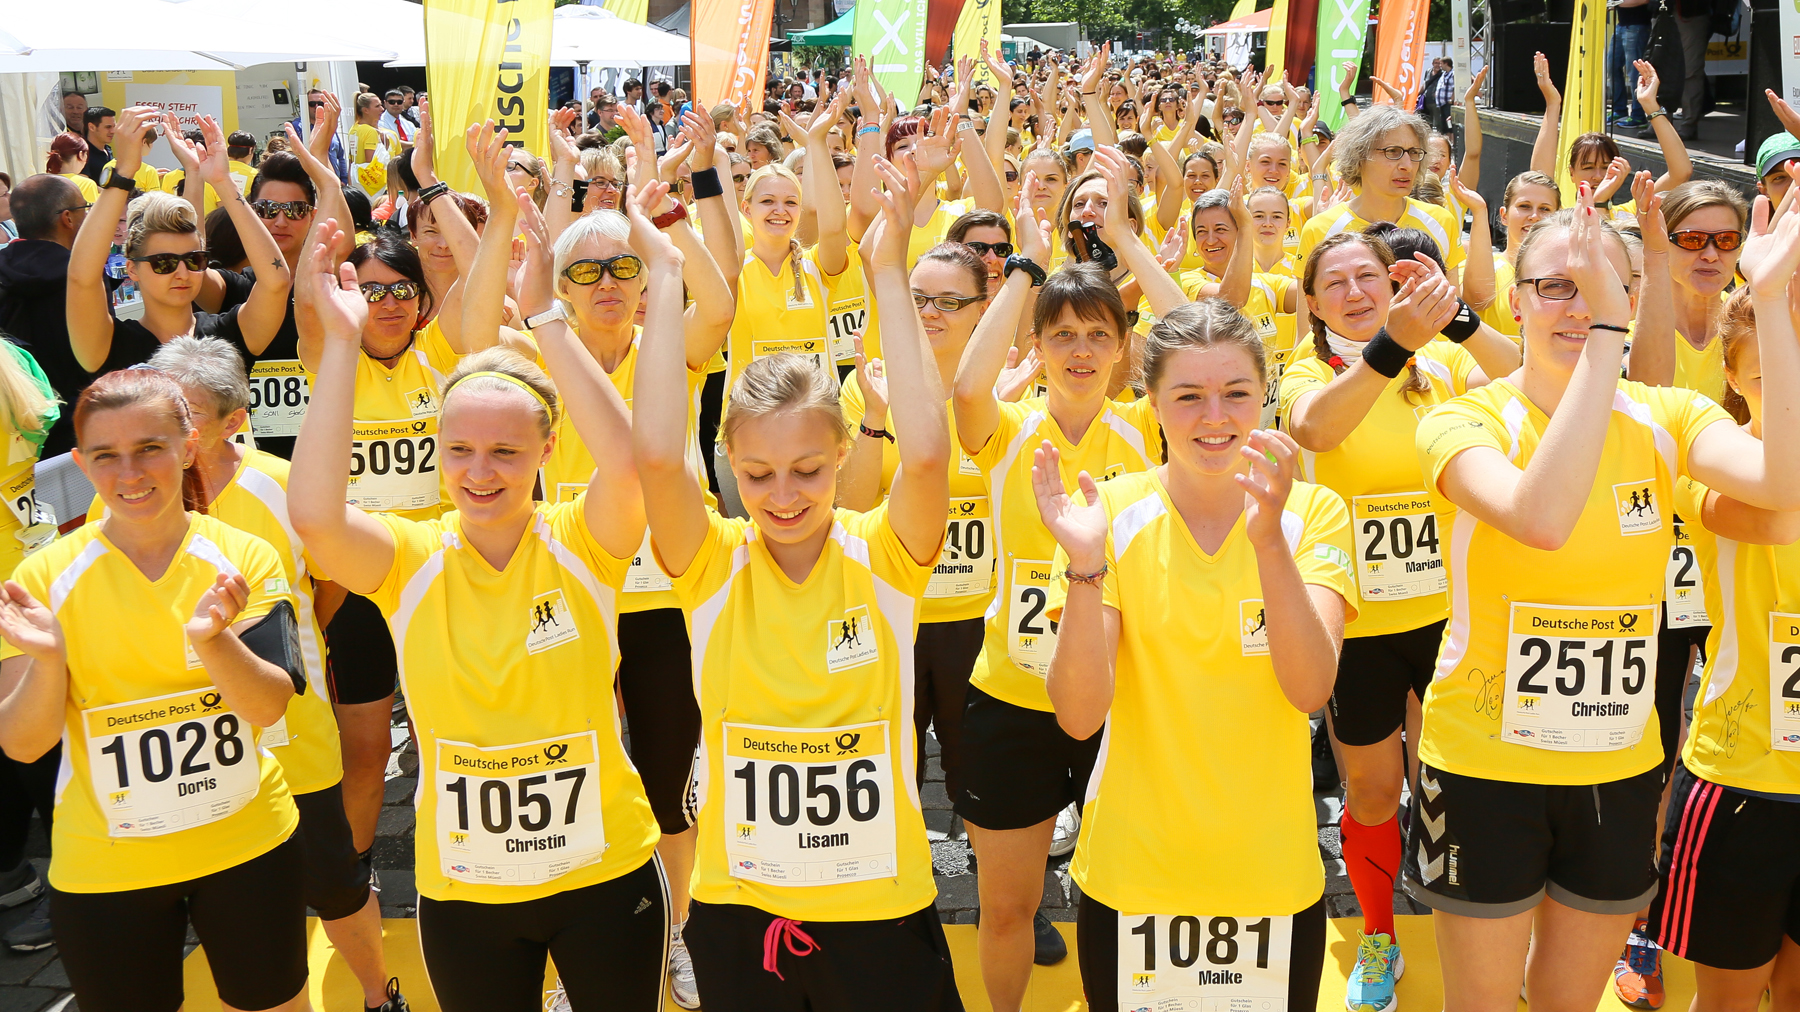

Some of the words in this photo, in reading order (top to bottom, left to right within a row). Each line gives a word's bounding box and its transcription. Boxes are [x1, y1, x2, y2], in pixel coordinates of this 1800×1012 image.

[915, 21, 925, 48] WILL
[914, 49, 923, 73] DAS
[493, 18, 525, 146] tsche
[168, 103, 198, 112] STEHT
[352, 427, 389, 436] Deutsche
[349, 436, 436, 476] 5092
[1367, 502, 1410, 513] Deutsche
[1411, 500, 1431, 509] Post
[931, 562, 973, 575] atharina
[1532, 616, 1589, 630] Deutsche
[1591, 618, 1615, 630] Post
[1517, 637, 1647, 697] 2515
[107, 704, 166, 727] Deutsche
[169, 702, 196, 716] Post
[1571, 701, 1630, 717] Christine
[101, 713, 244, 789] 1028
[743, 737, 798, 754] Deutsche
[801, 742, 831, 754] Post
[454, 754, 508, 770] Deutsche
[511, 754, 540, 768] Post
[177, 776, 217, 798] Doris
[734, 758, 880, 827] 1056
[445, 767, 587, 834] 1057
[505, 834, 566, 853] Christin
[798, 831, 849, 849] Lisann
[836, 860, 860, 868] Gutschein
[1448, 844, 1460, 886] hummel
[1131, 915, 1271, 971] 1081
[1198, 970, 1243, 986] Maike
